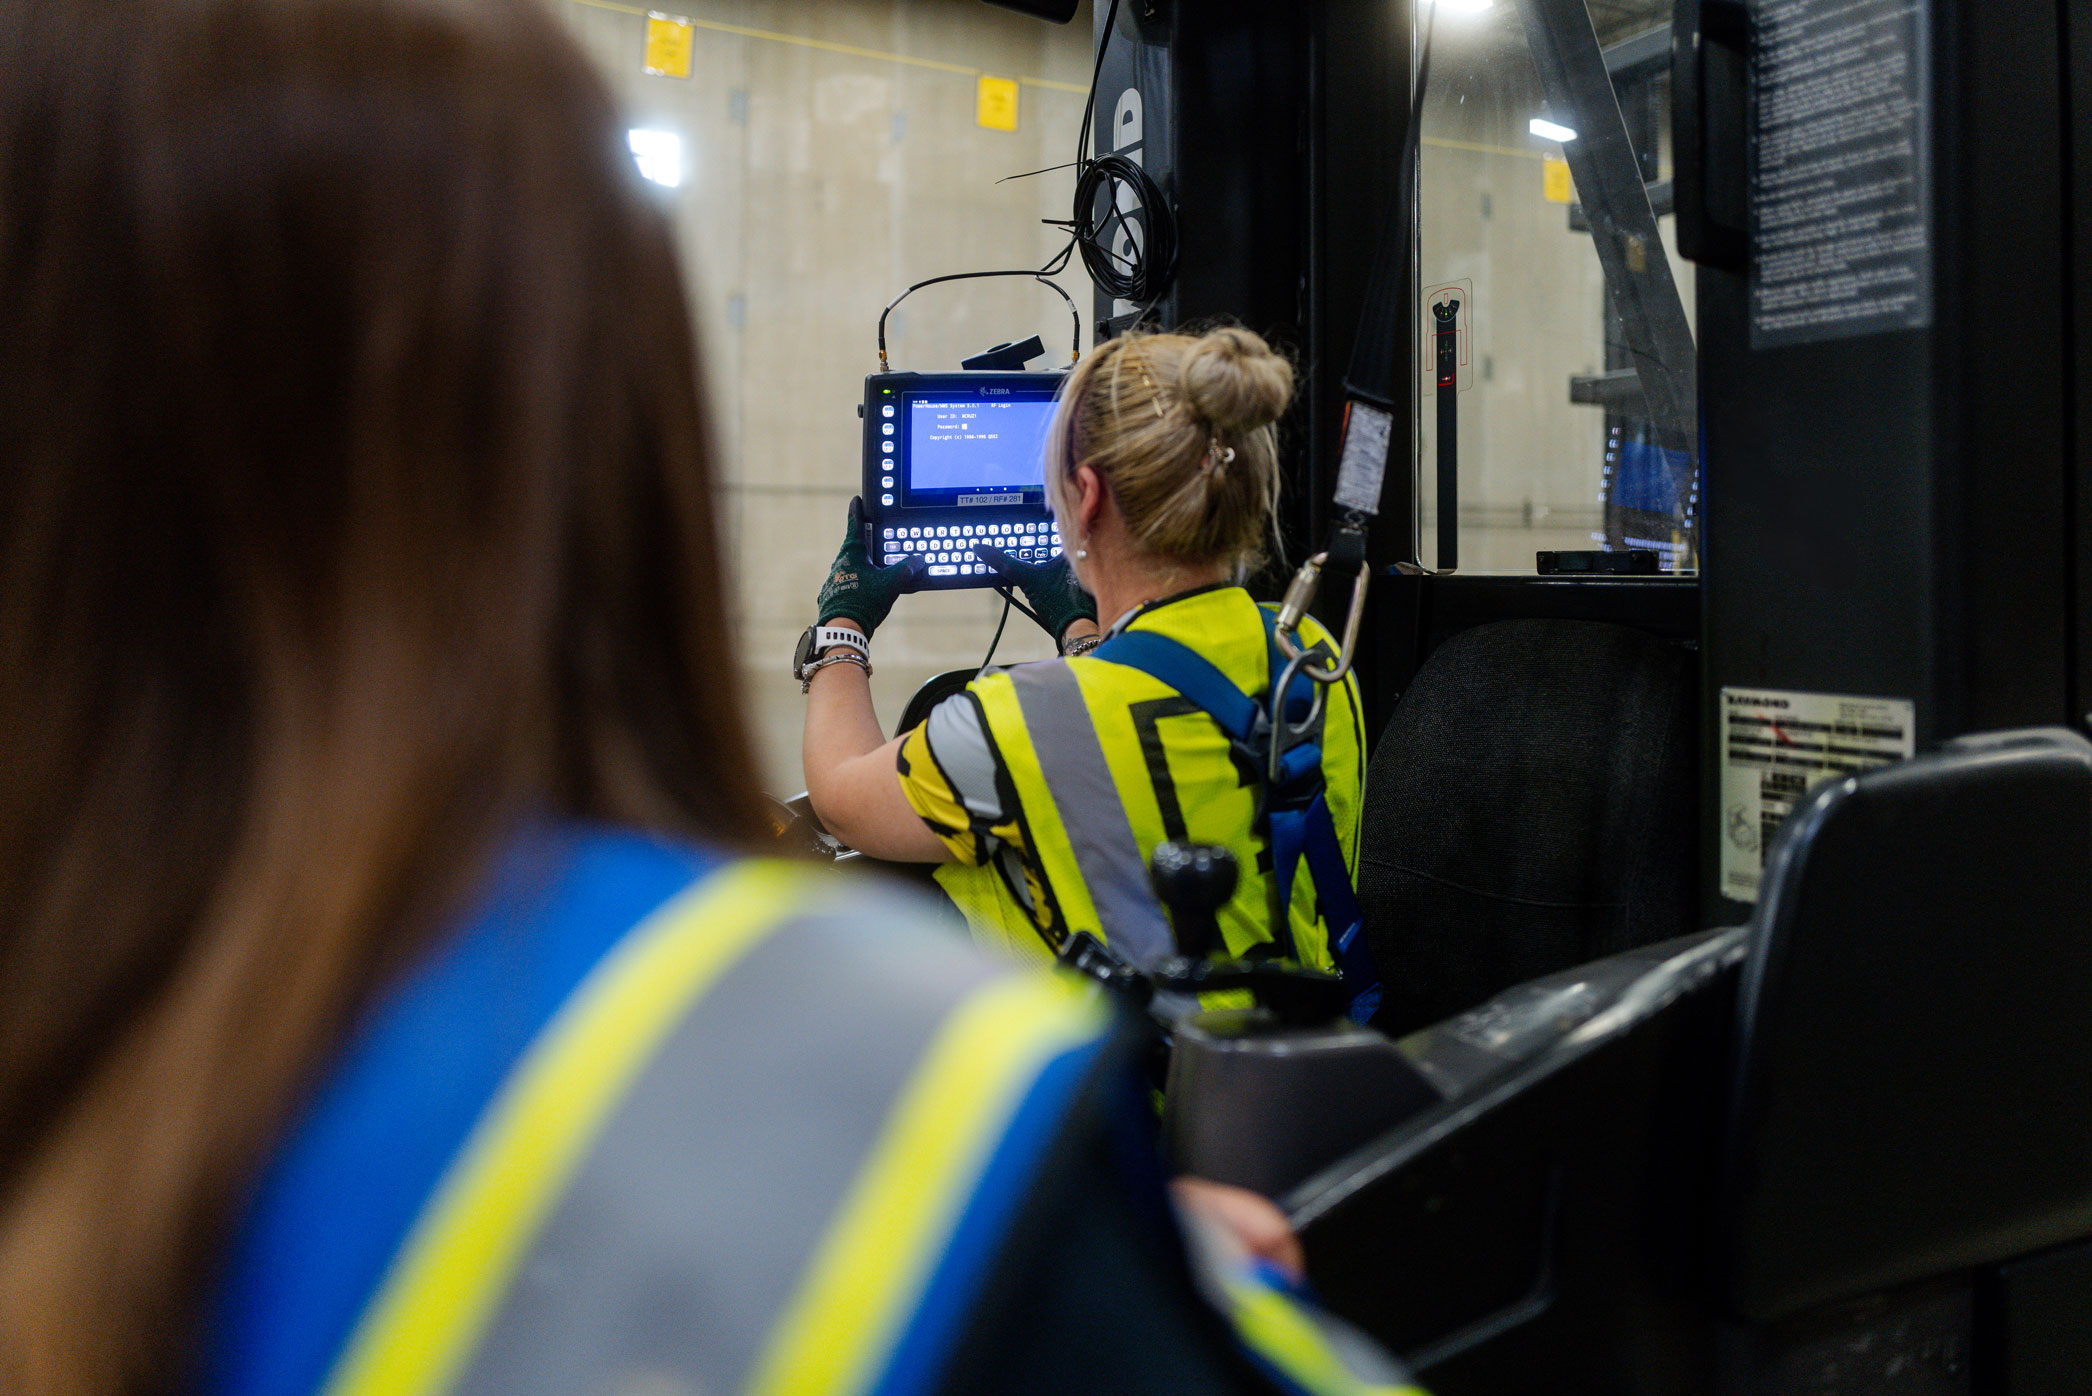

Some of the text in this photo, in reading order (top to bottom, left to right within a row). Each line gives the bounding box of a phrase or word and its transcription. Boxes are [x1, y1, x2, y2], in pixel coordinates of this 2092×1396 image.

[975, 496, 988, 504] 102
[993, 495, 1008, 503] RF#
[1008, 495, 1022, 503] 281
